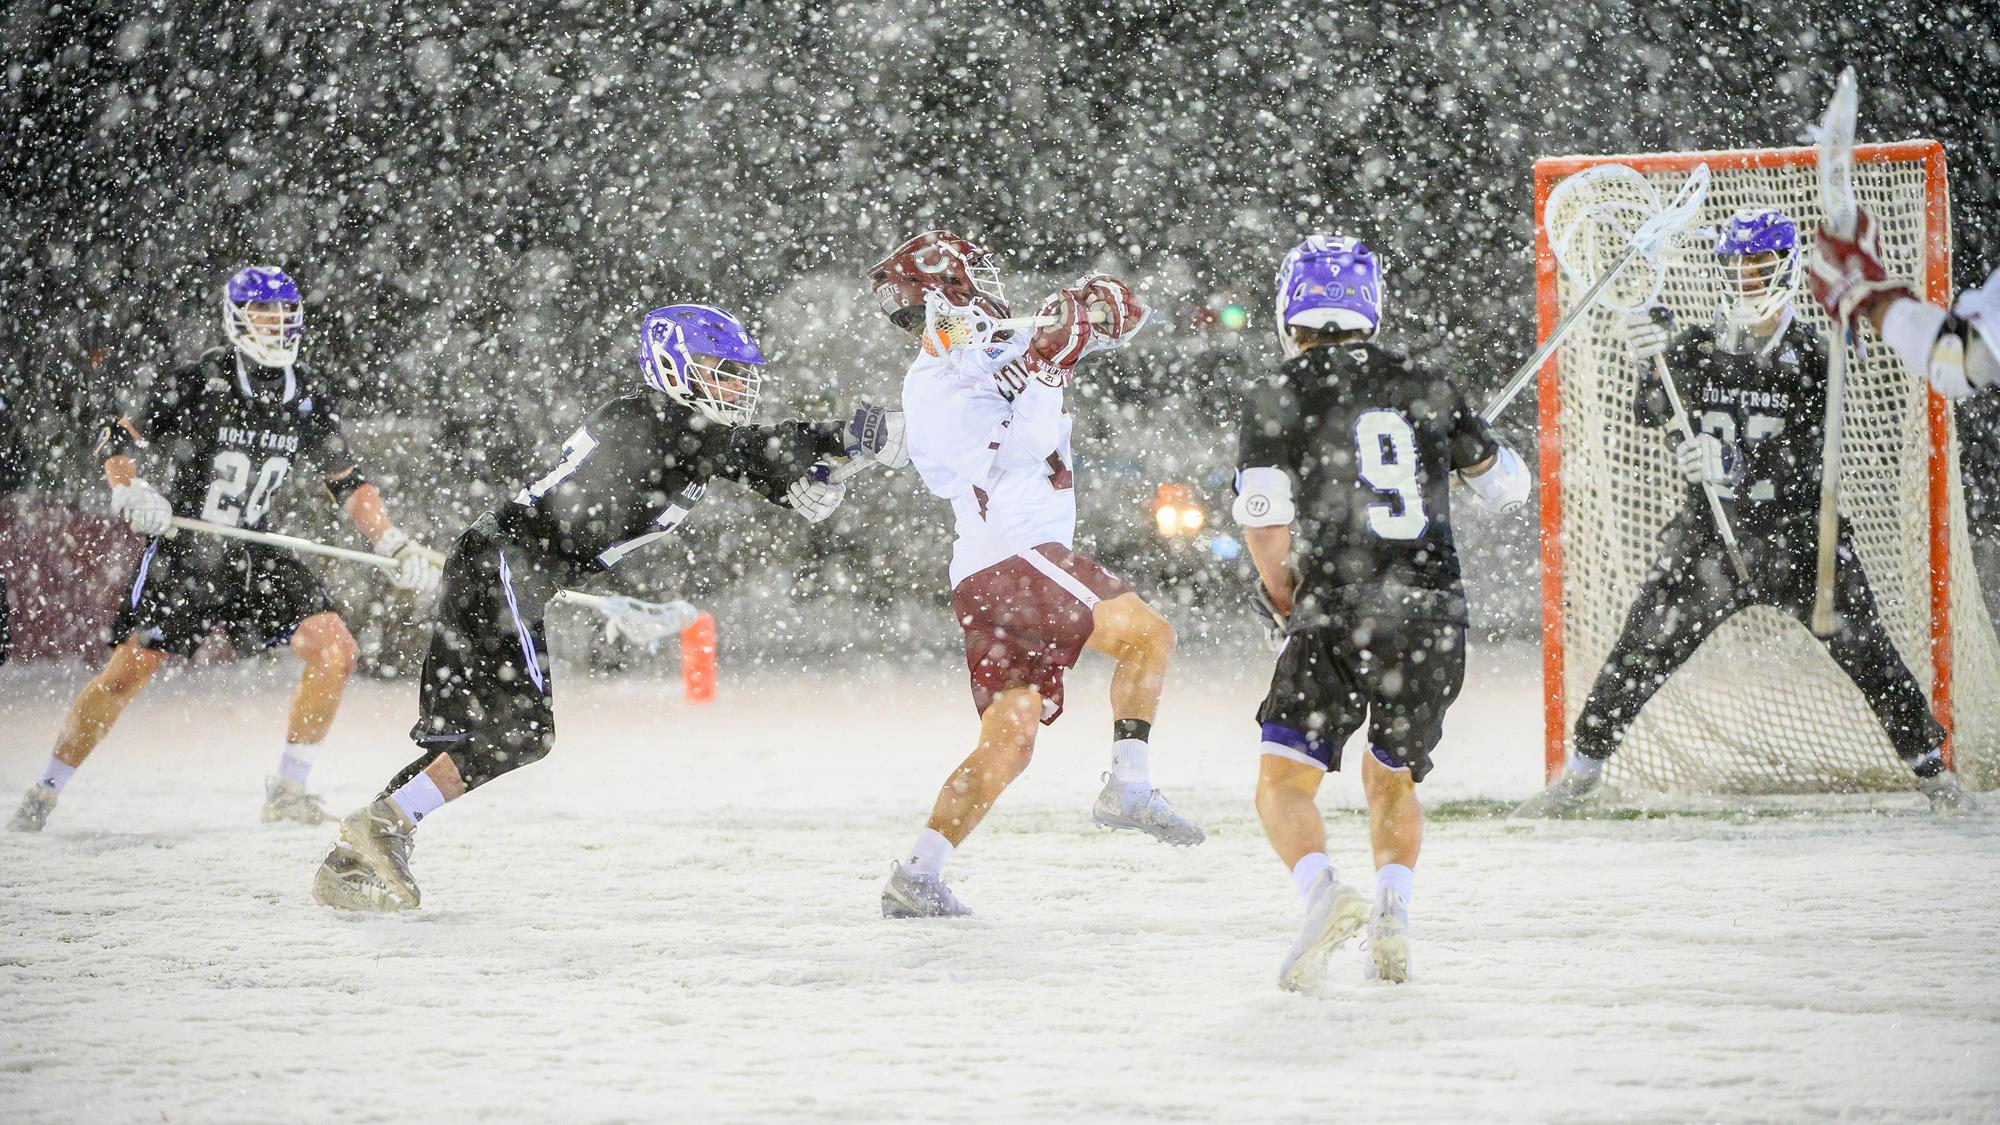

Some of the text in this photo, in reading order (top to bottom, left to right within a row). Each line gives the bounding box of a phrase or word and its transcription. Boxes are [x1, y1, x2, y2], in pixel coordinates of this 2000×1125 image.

[1330, 264, 1341, 277] 9
[1702, 387, 1789, 409] HOLY CROSS
[218, 426, 300, 452] HOLY CROSS
[1353, 408, 1429, 540] 9
[200, 451, 288, 526] 20
